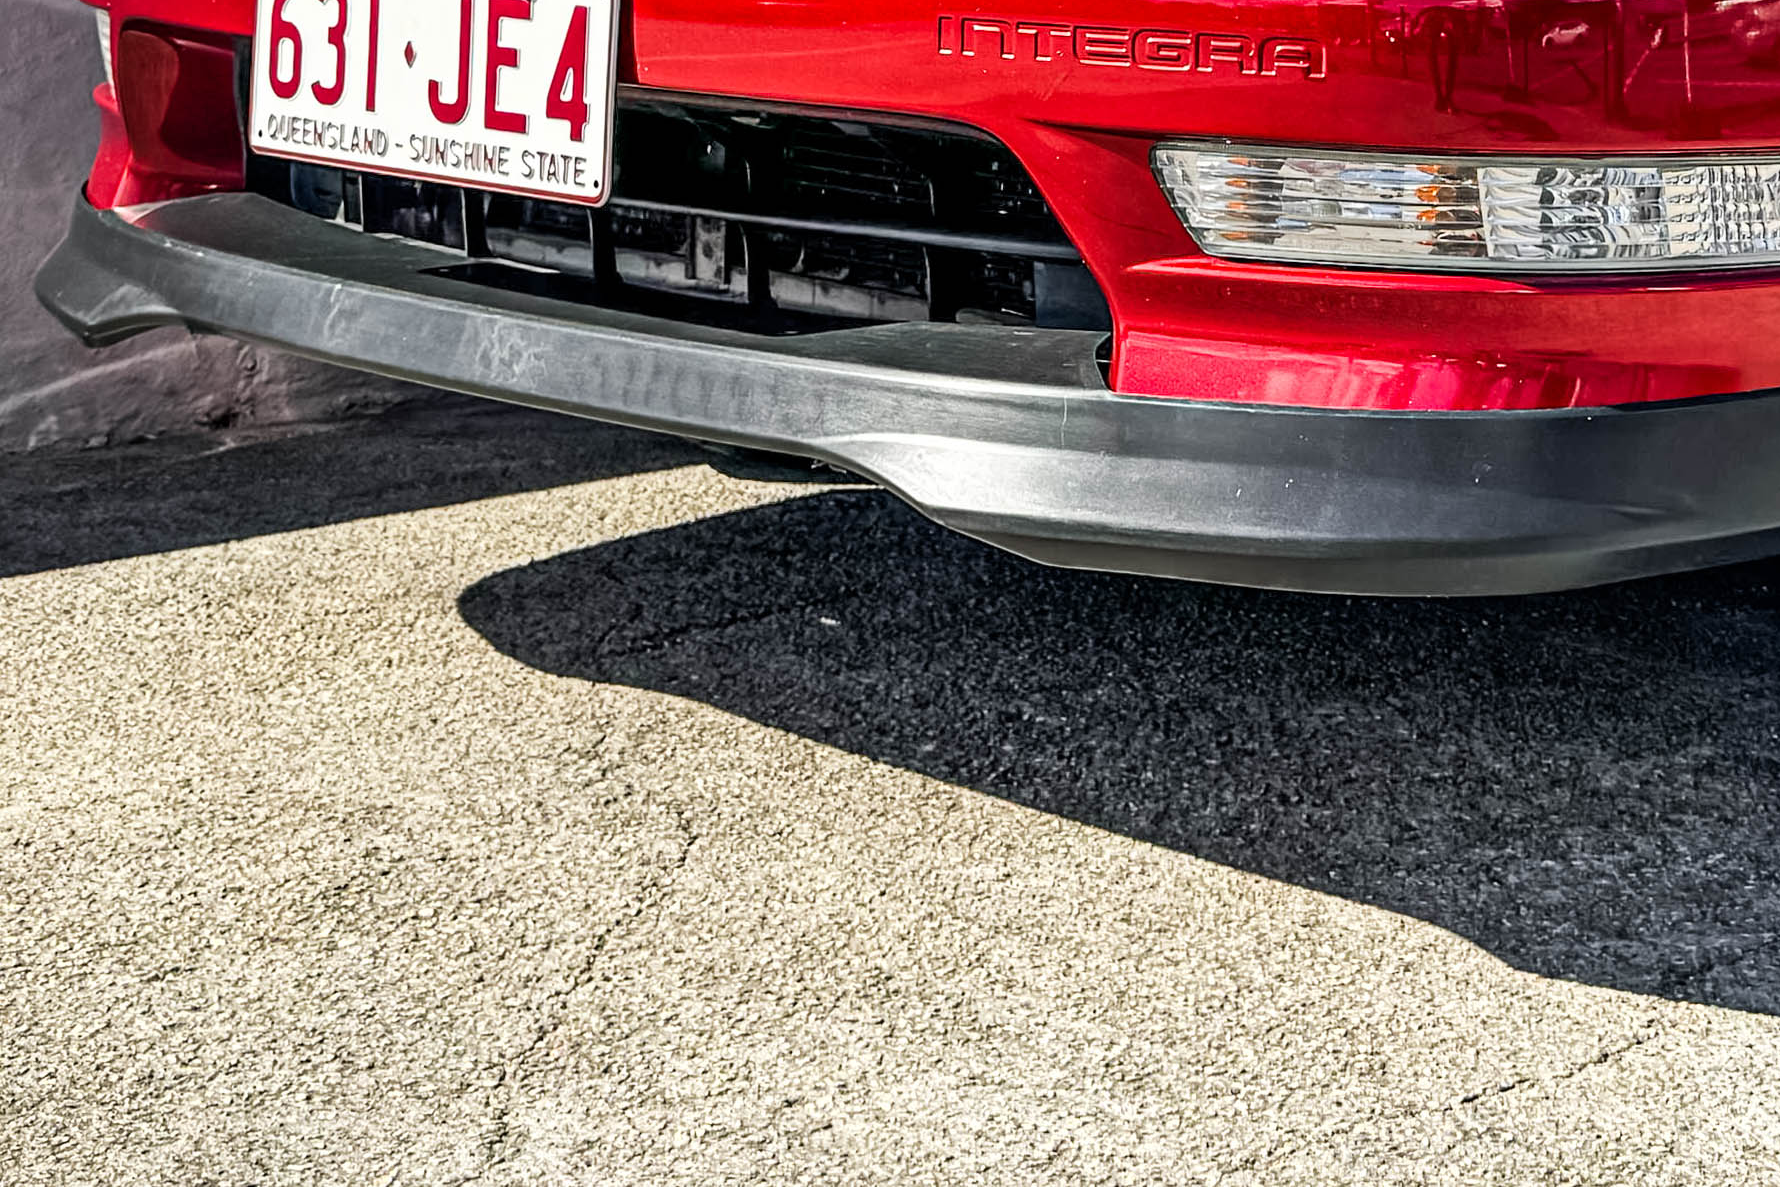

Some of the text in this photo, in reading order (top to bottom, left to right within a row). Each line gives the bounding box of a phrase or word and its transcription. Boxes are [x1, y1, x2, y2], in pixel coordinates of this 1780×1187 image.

[937, 13, 1327, 79] INTEGRA
[267, 113, 390, 157] QUEENSLAND
[408, 133, 511, 176] SUNSHINE
[520, 149, 588, 188] STATE
